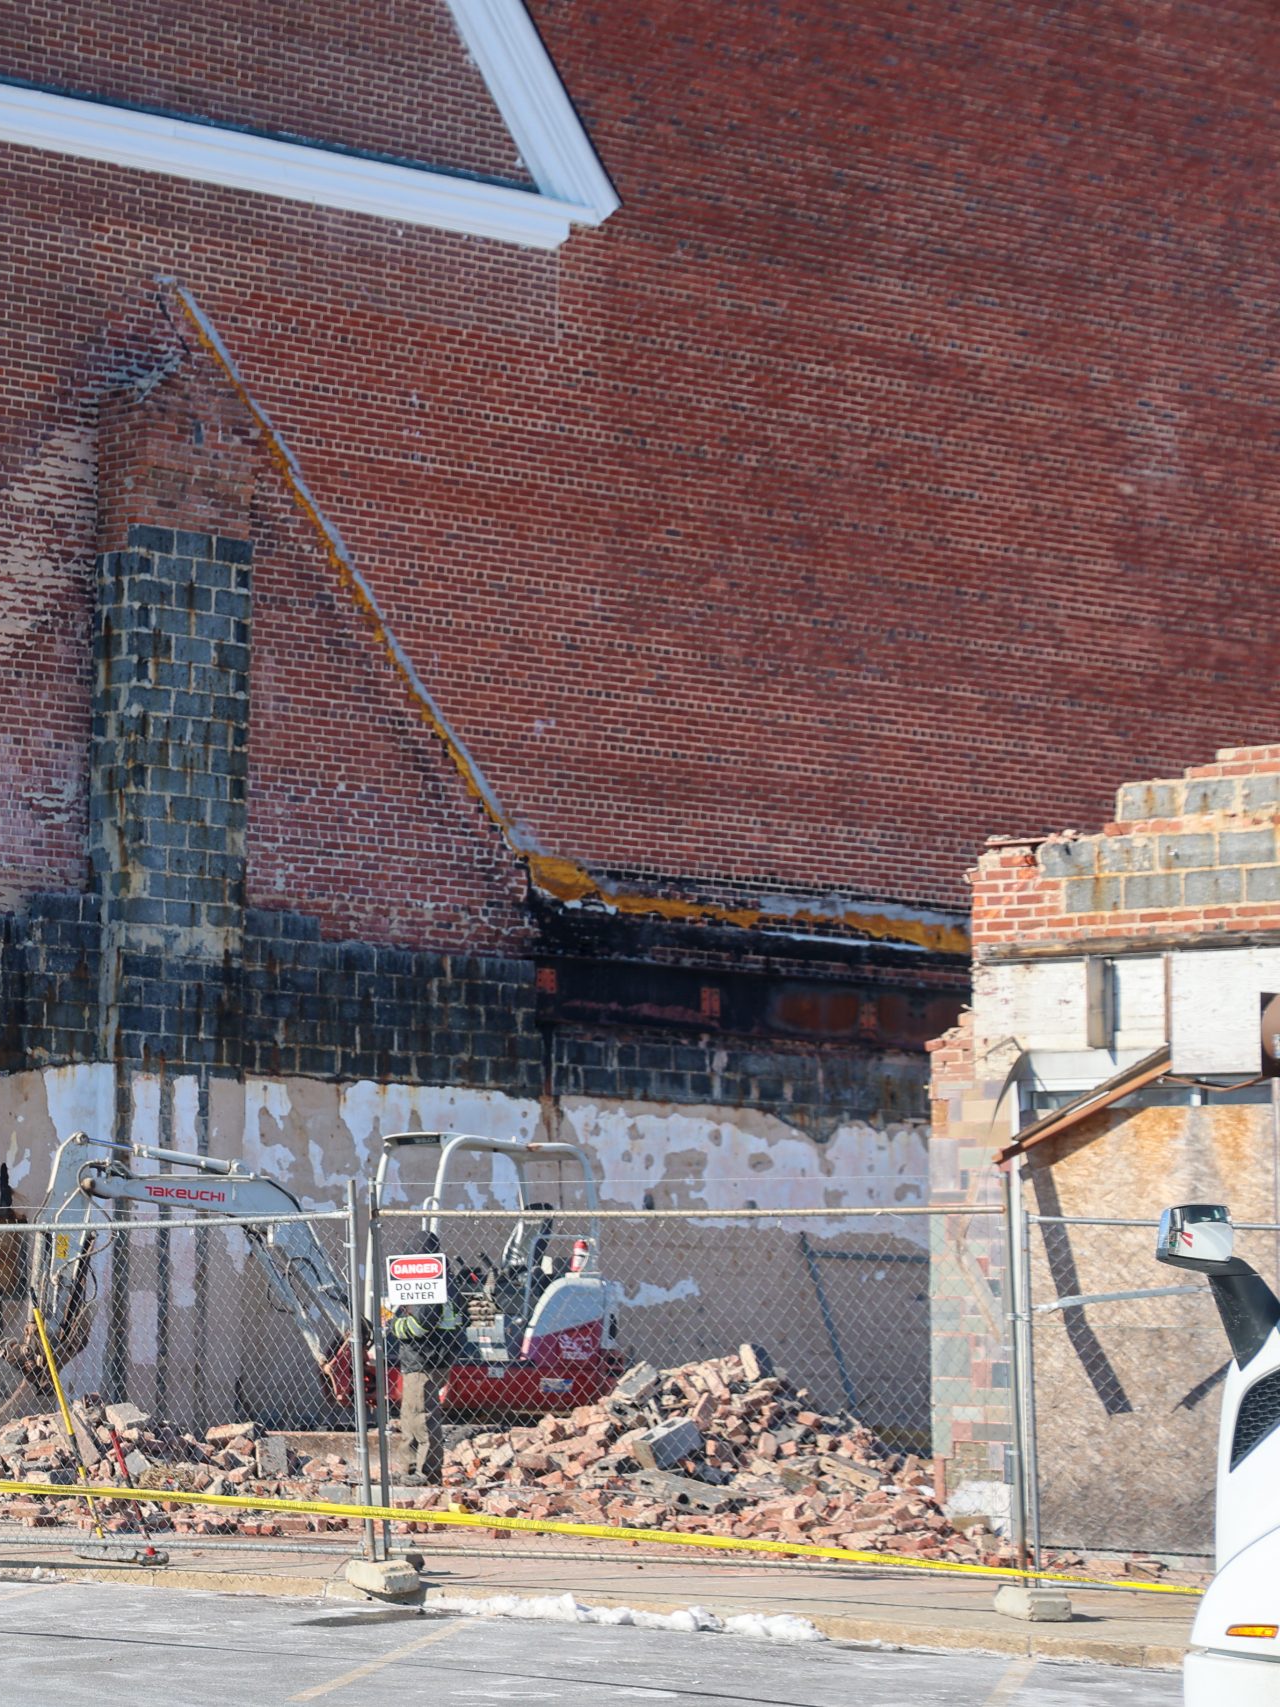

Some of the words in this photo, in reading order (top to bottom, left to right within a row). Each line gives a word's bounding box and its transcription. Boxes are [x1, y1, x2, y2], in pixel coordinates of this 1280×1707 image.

[144, 1186, 225, 1202] TAKEUCHI
[393, 1263, 439, 1275] DANGER
[395, 1283, 412, 1291] DO
[415, 1282, 438, 1290] NOT
[400, 1292, 434, 1300] ENTER
